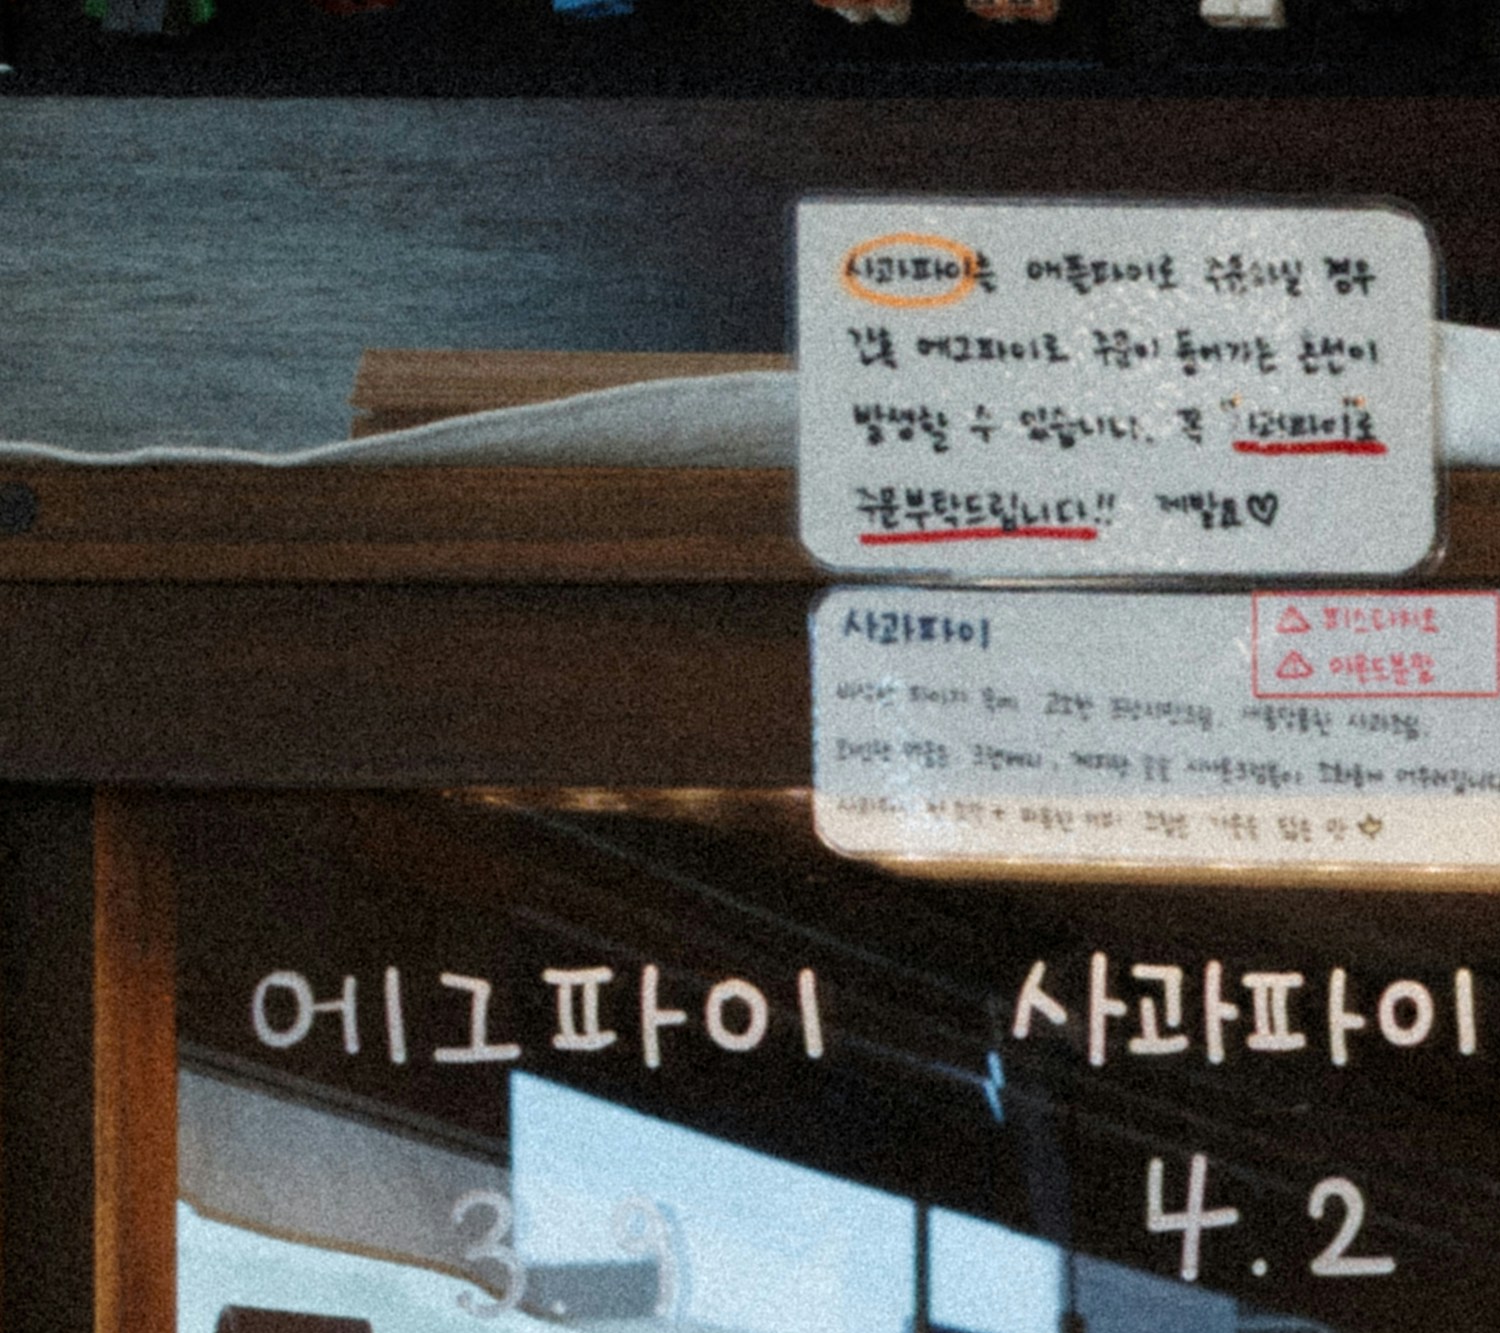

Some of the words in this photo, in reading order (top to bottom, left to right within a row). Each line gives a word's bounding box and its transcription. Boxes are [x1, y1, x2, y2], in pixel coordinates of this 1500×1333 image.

[844, 609, 990, 650] 사과파이
[251, 963, 825, 1069] 에그파이
[1012, 952, 1477, 1067] 사과파이
[450, 1190, 686, 1318] 3.9
[1147, 1152, 1398, 1282] 4.2
